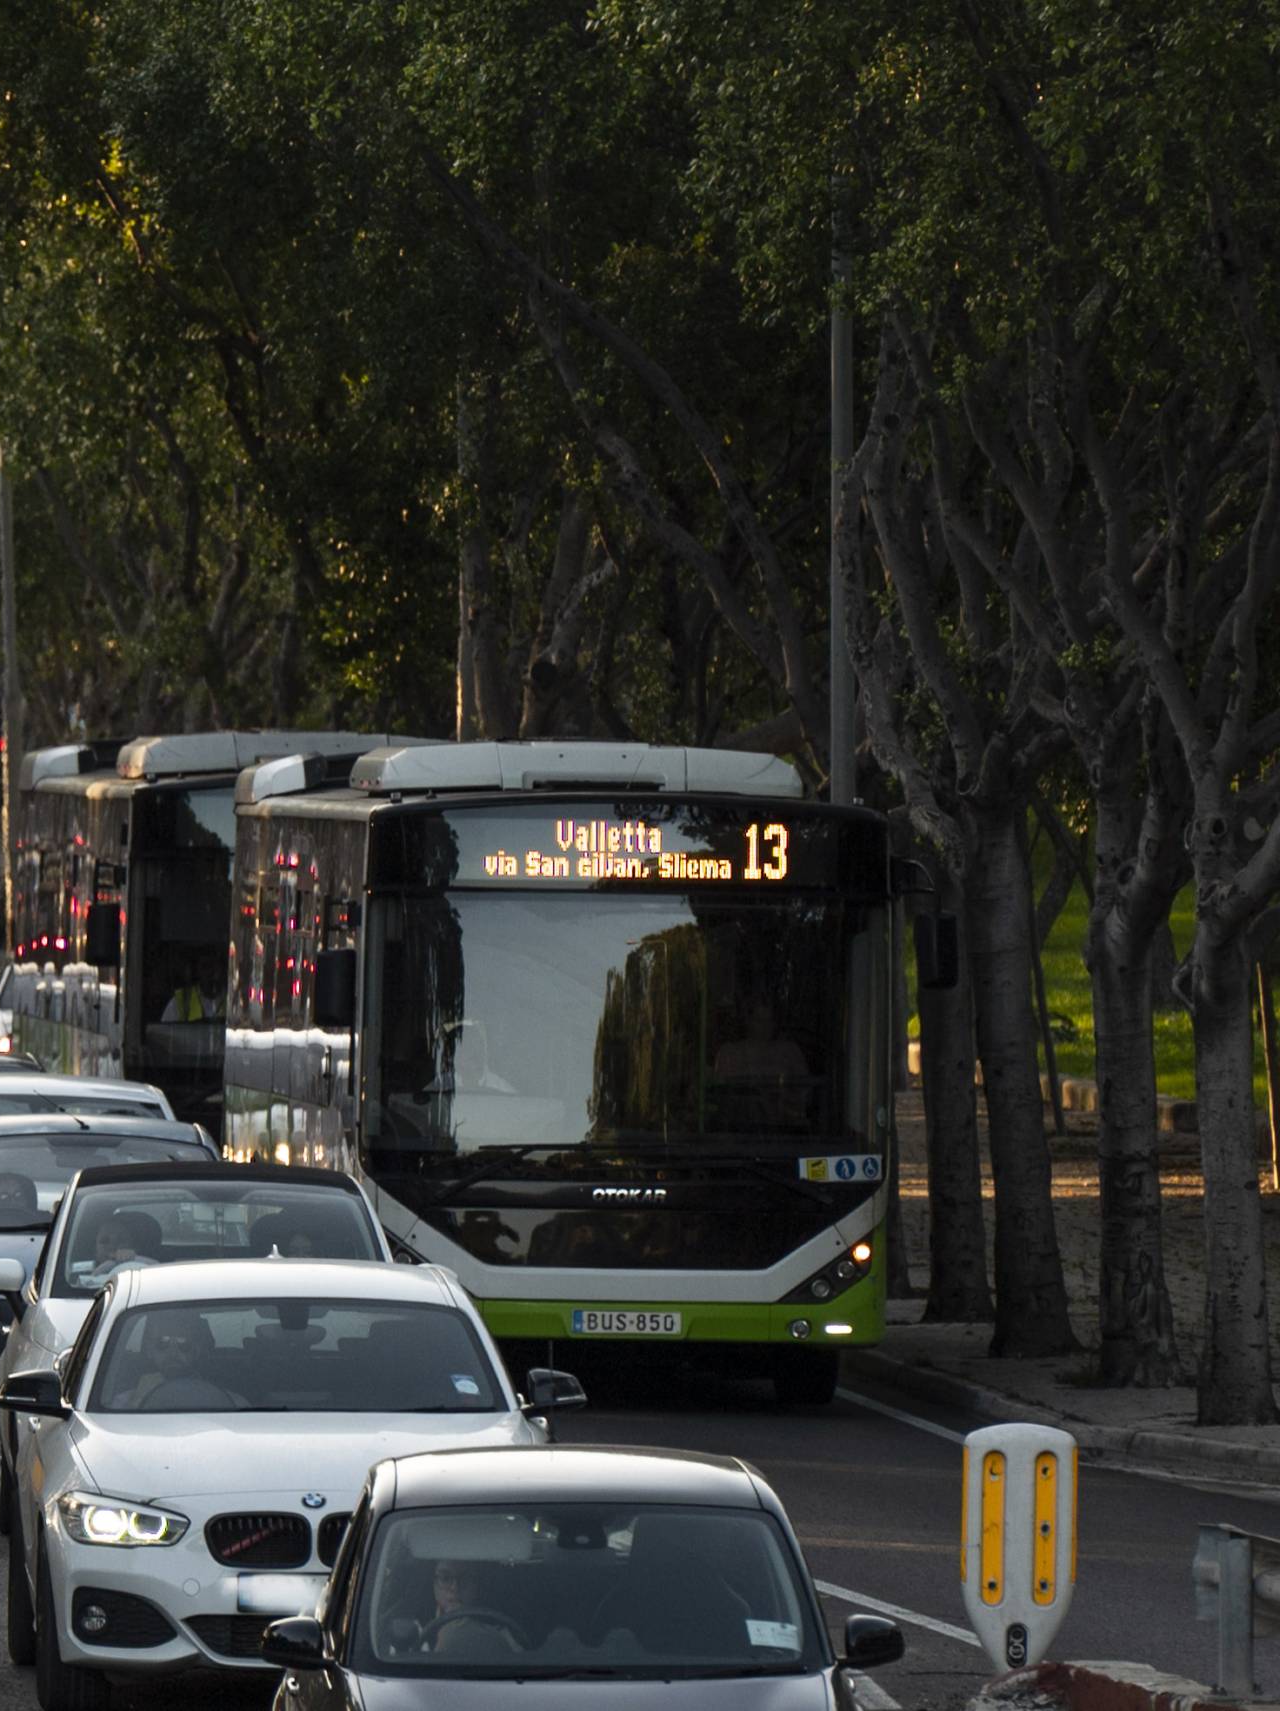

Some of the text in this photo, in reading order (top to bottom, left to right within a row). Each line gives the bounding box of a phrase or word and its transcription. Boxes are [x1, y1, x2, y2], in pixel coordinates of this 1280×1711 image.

[555, 820, 663, 853] Valletta
[744, 823, 790, 880] 13
[484, 851, 518, 877] via
[525, 851, 570, 878] San
[659, 852, 732, 880] Sliema
